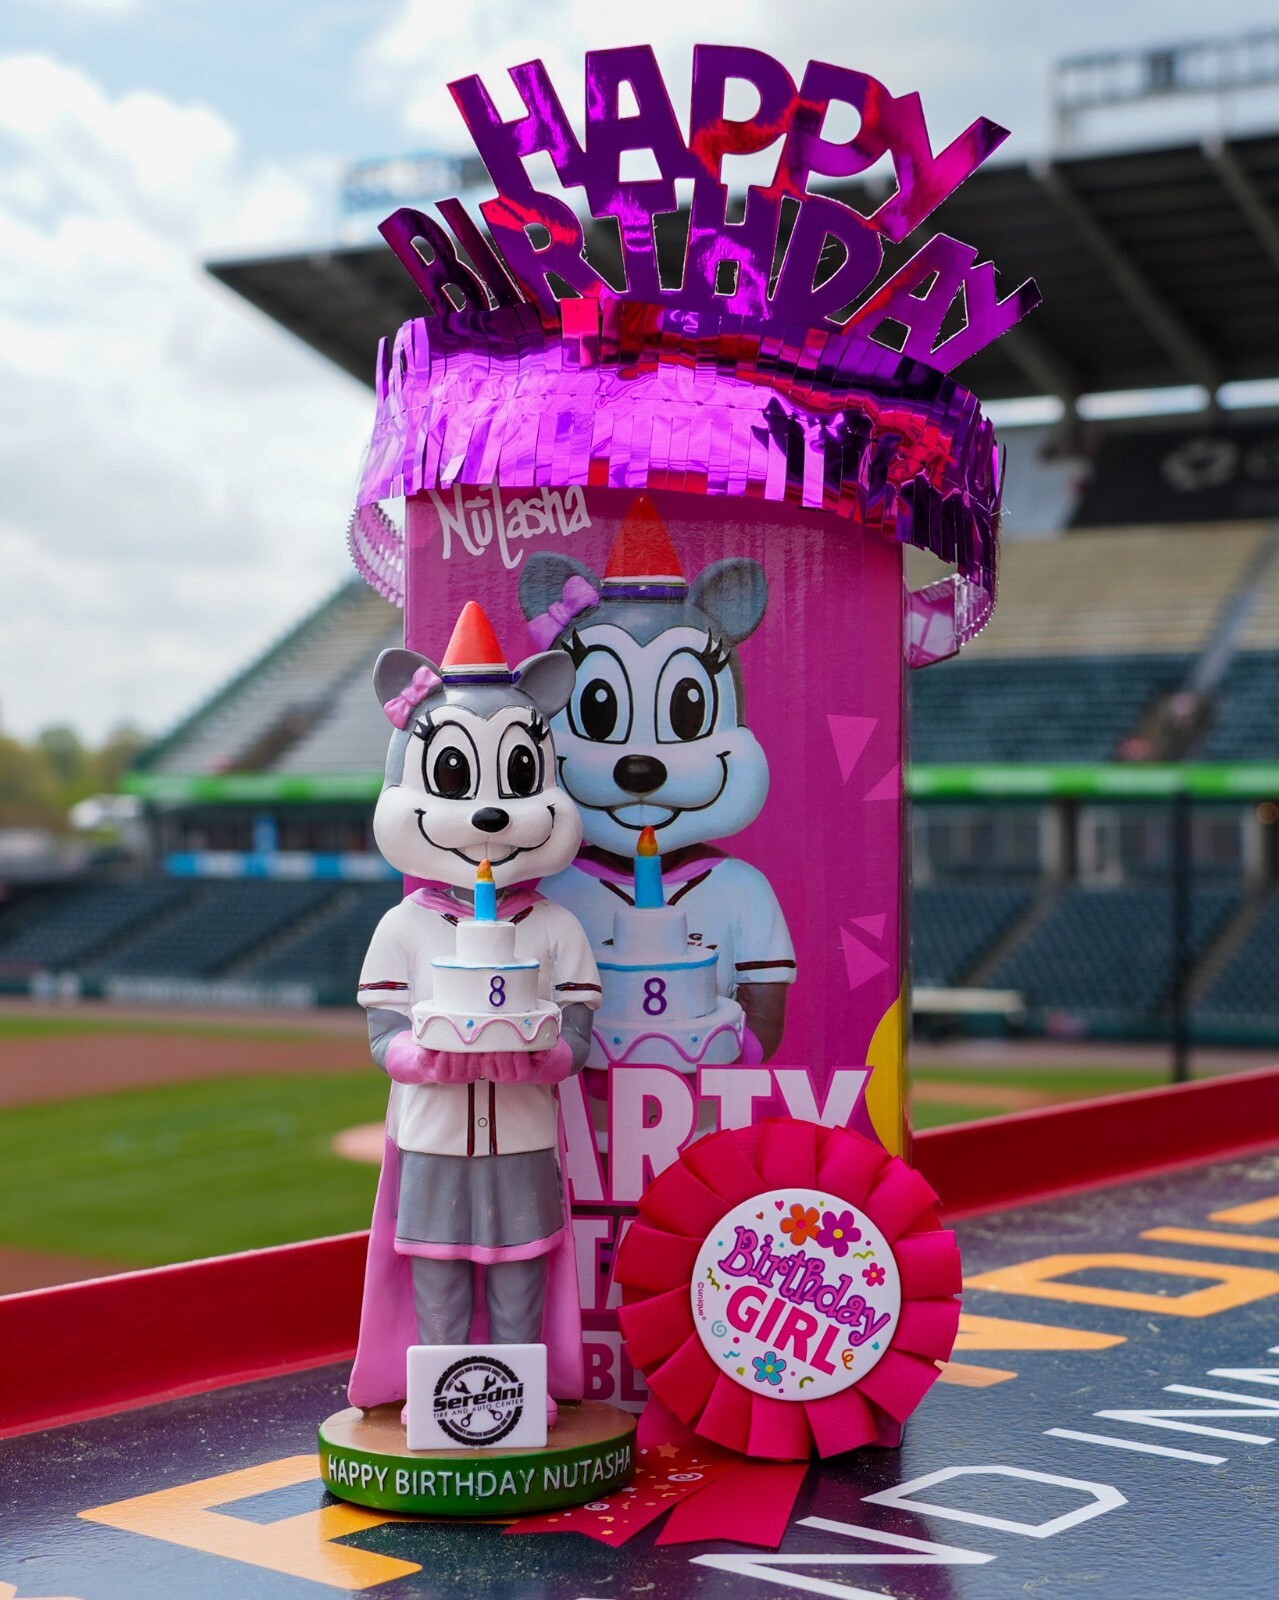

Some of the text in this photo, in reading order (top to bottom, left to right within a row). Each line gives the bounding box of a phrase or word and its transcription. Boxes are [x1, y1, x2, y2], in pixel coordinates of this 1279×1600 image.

[447, 43, 1011, 244] HAPPY
[377, 178, 1043, 372] BIRTHDAY
[488, 975, 506, 1008] 8
[643, 977, 668, 1016] 8
[718, 1226, 891, 1347] Birthday
[726, 1285, 840, 1376] GIRL
[433, 1382, 524, 1412] Seredni
[433, 1398, 524, 1419] TIRE AND AUTO CENTER
[328, 1445, 632, 1497] HAPPY BIRTHDAY NUTASHA
